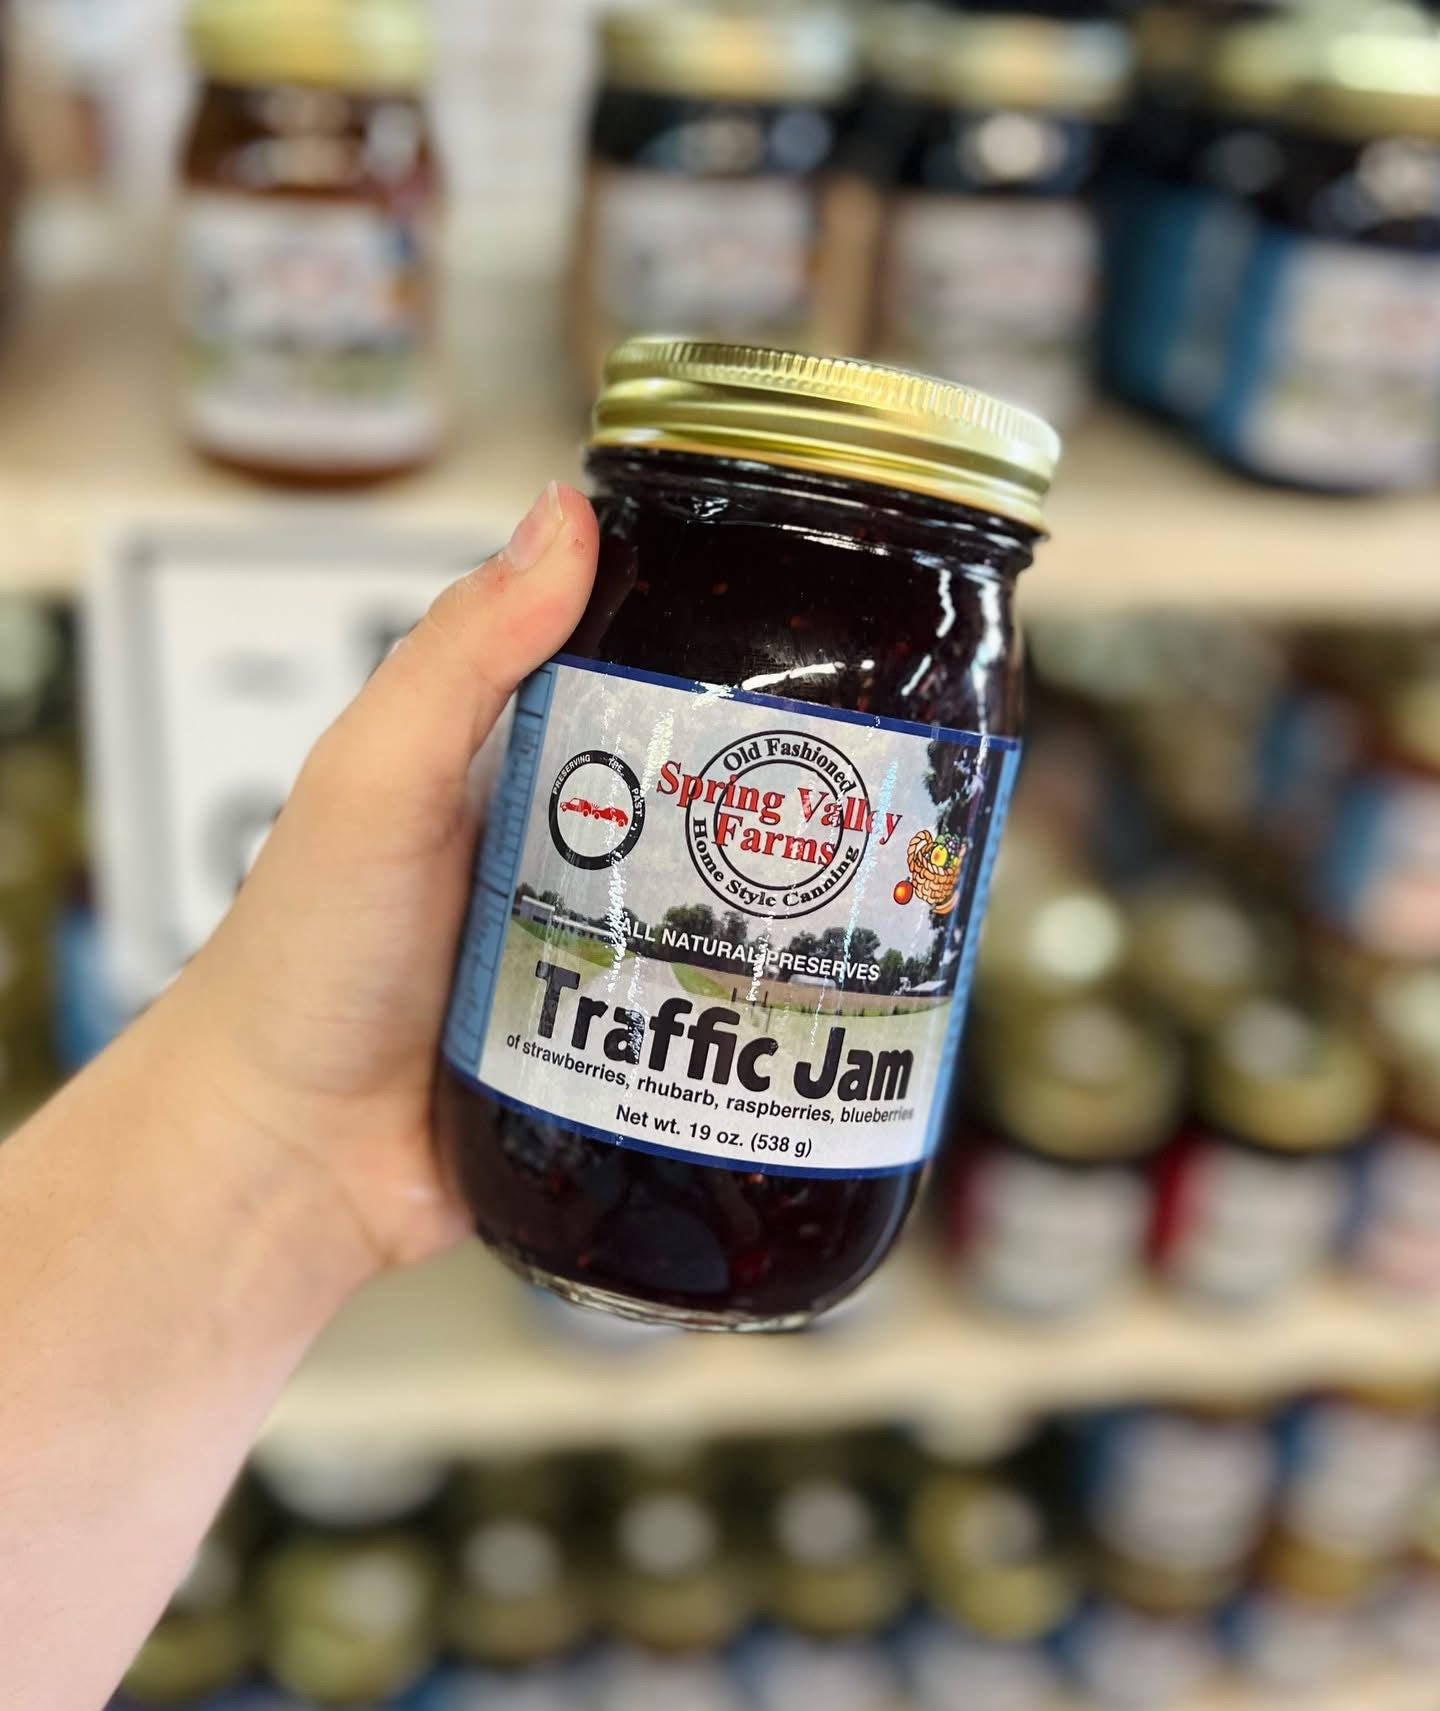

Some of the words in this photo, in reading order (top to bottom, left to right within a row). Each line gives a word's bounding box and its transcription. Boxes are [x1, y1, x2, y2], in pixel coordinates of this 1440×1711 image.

[552, 754, 591, 795] PRESERVING
[723, 742, 762, 771] Old
[764, 738, 857, 794] Fashioned
[656, 760, 786, 826] Spring
[797, 787, 903, 845] Valley
[693, 817, 725, 882] Home
[726, 879, 777, 907] Style
[782, 845, 860, 907] Canning
[712, 812, 836, 867] Farms
[620, 918, 656, 942] ALL
[661, 930, 762, 965] NATURAL
[765, 950, 880, 982] PRESERVES
[535, 960, 779, 1092] Traffic
[794, 1027, 914, 1101] Jam
[507, 1035, 520, 1049] of
[523, 1041, 630, 1089] strawberries,
[637, 1076, 719, 1109] rhubarb,
[726, 1096, 835, 1124] raspberries,
[840, 1107, 914, 1123] blueberries
[616, 1104, 649, 1127] Net
[654, 1117, 680, 1135] wt.
[690, 1123, 711, 1140] 19
[717, 1131, 743, 1146] oz.
[751, 1132, 790, 1152] (538
[794, 1138, 812, 1157] g)
